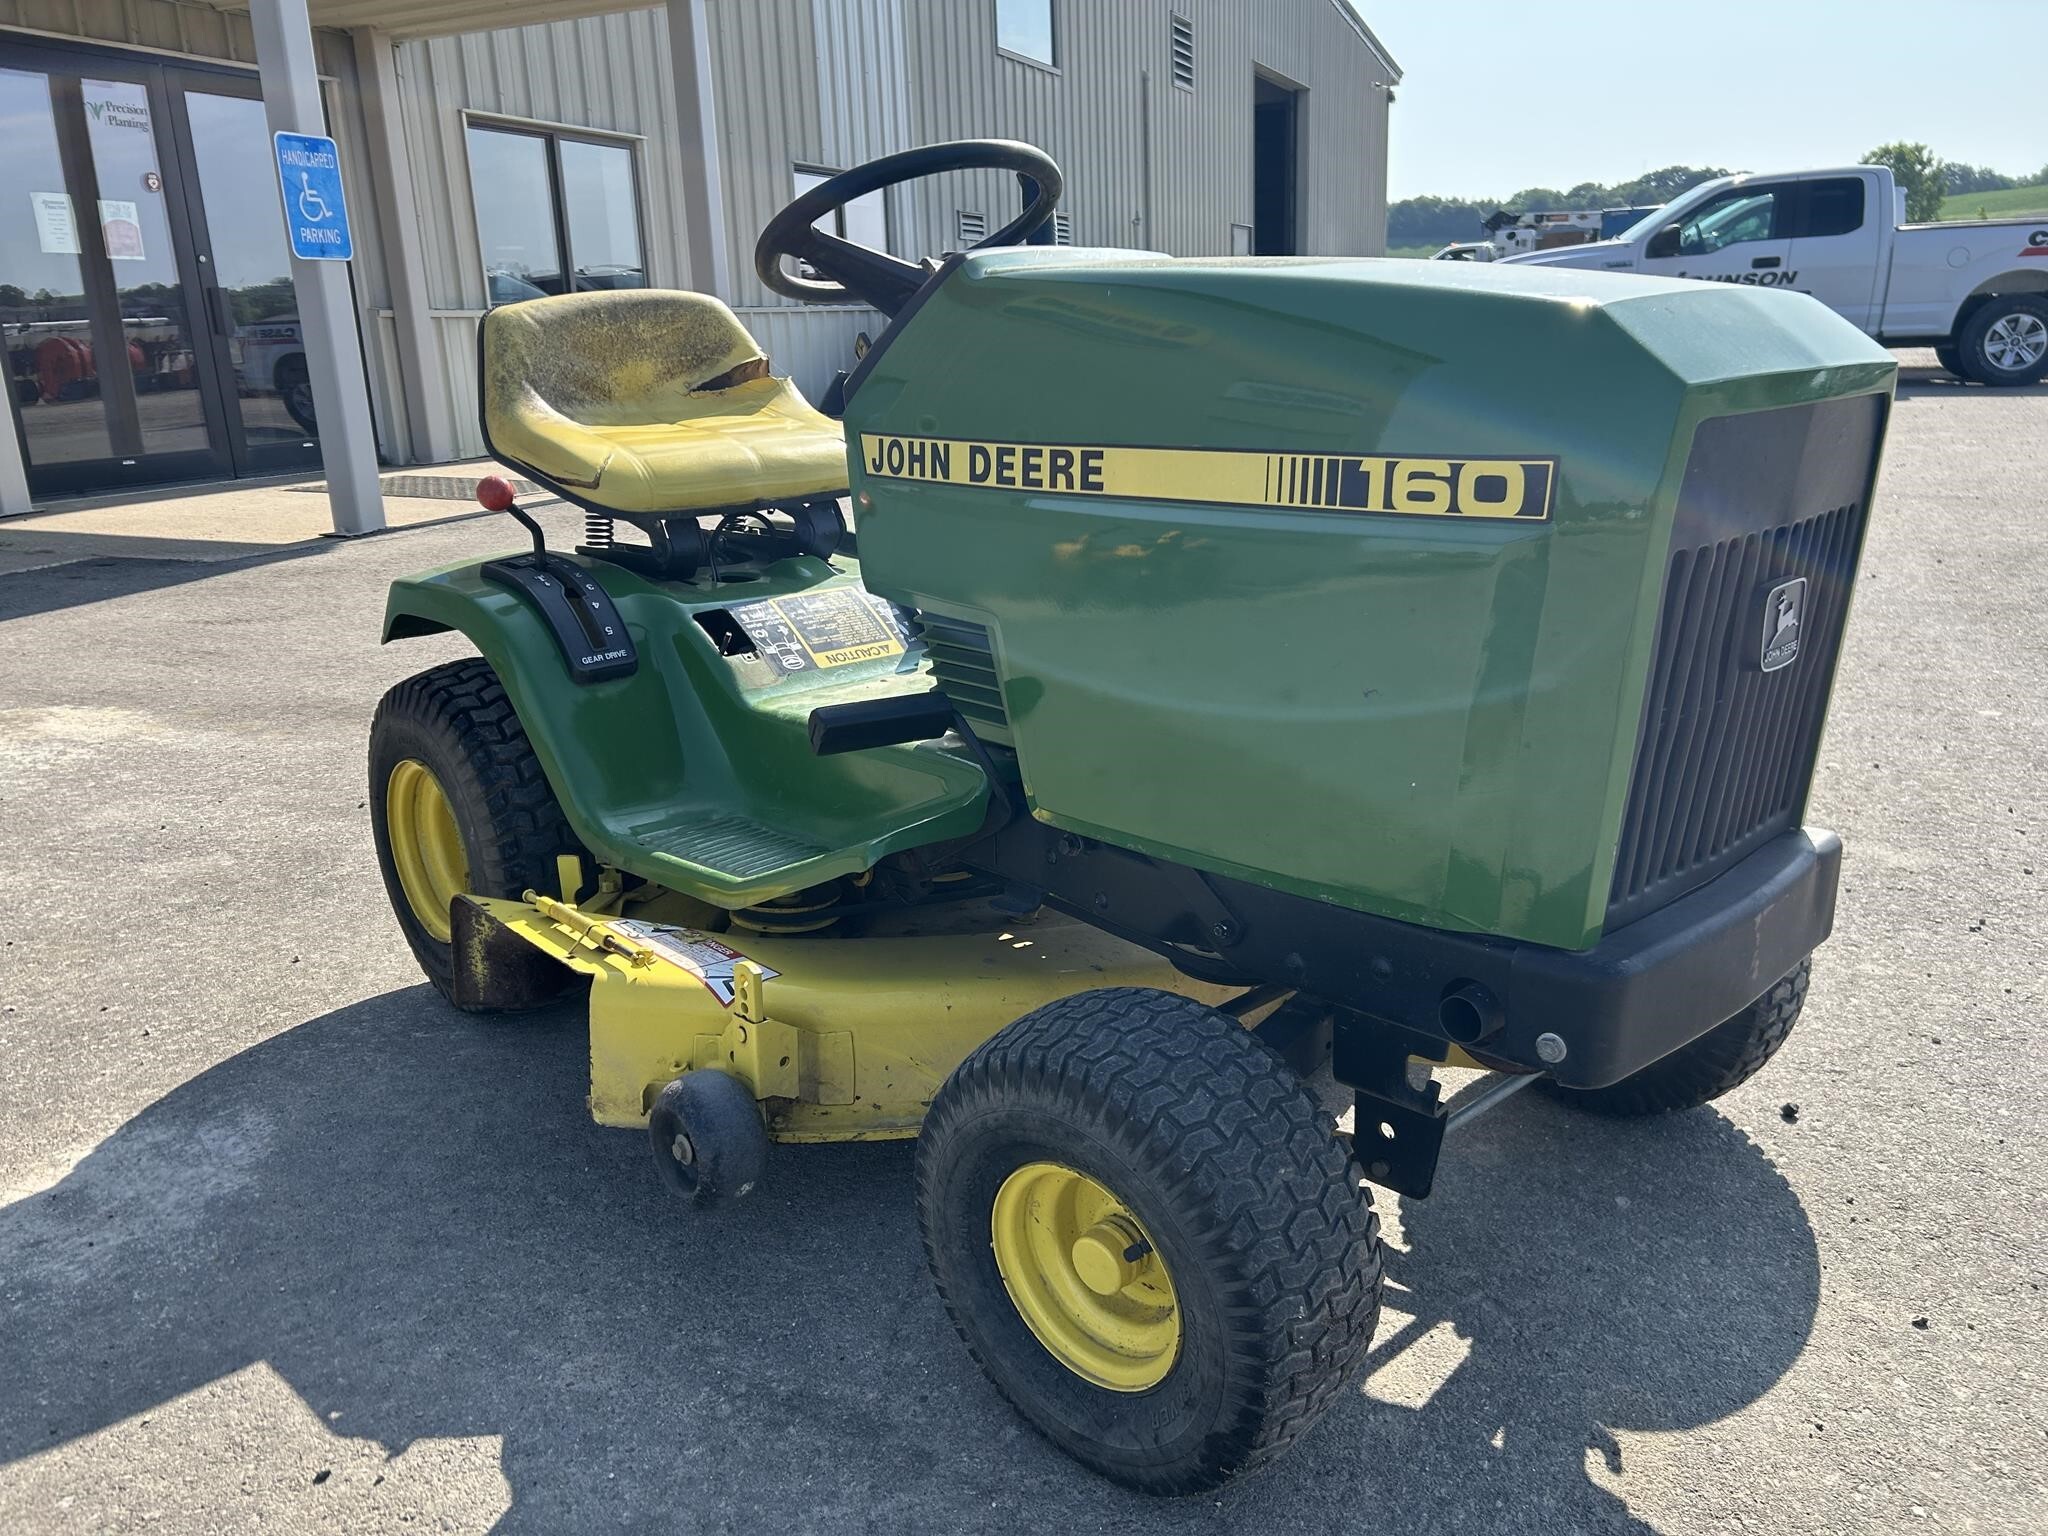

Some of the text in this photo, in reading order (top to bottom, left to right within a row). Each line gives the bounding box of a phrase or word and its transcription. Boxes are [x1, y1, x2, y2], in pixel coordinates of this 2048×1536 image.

[105, 101, 147, 115] Precision
[108, 115, 149, 132] Planting
[281, 150, 334, 169] HANDICAPPED
[301, 227, 341, 244] PARKING
[872, 438, 1525, 516] JOHN DEERE 160
[604, 626, 614, 636] 5
[581, 649, 627, 665] GEAR DRIVE
[826, 645, 881, 665] CAUTION
[1764, 640, 1798, 663] JOHN DEERE
